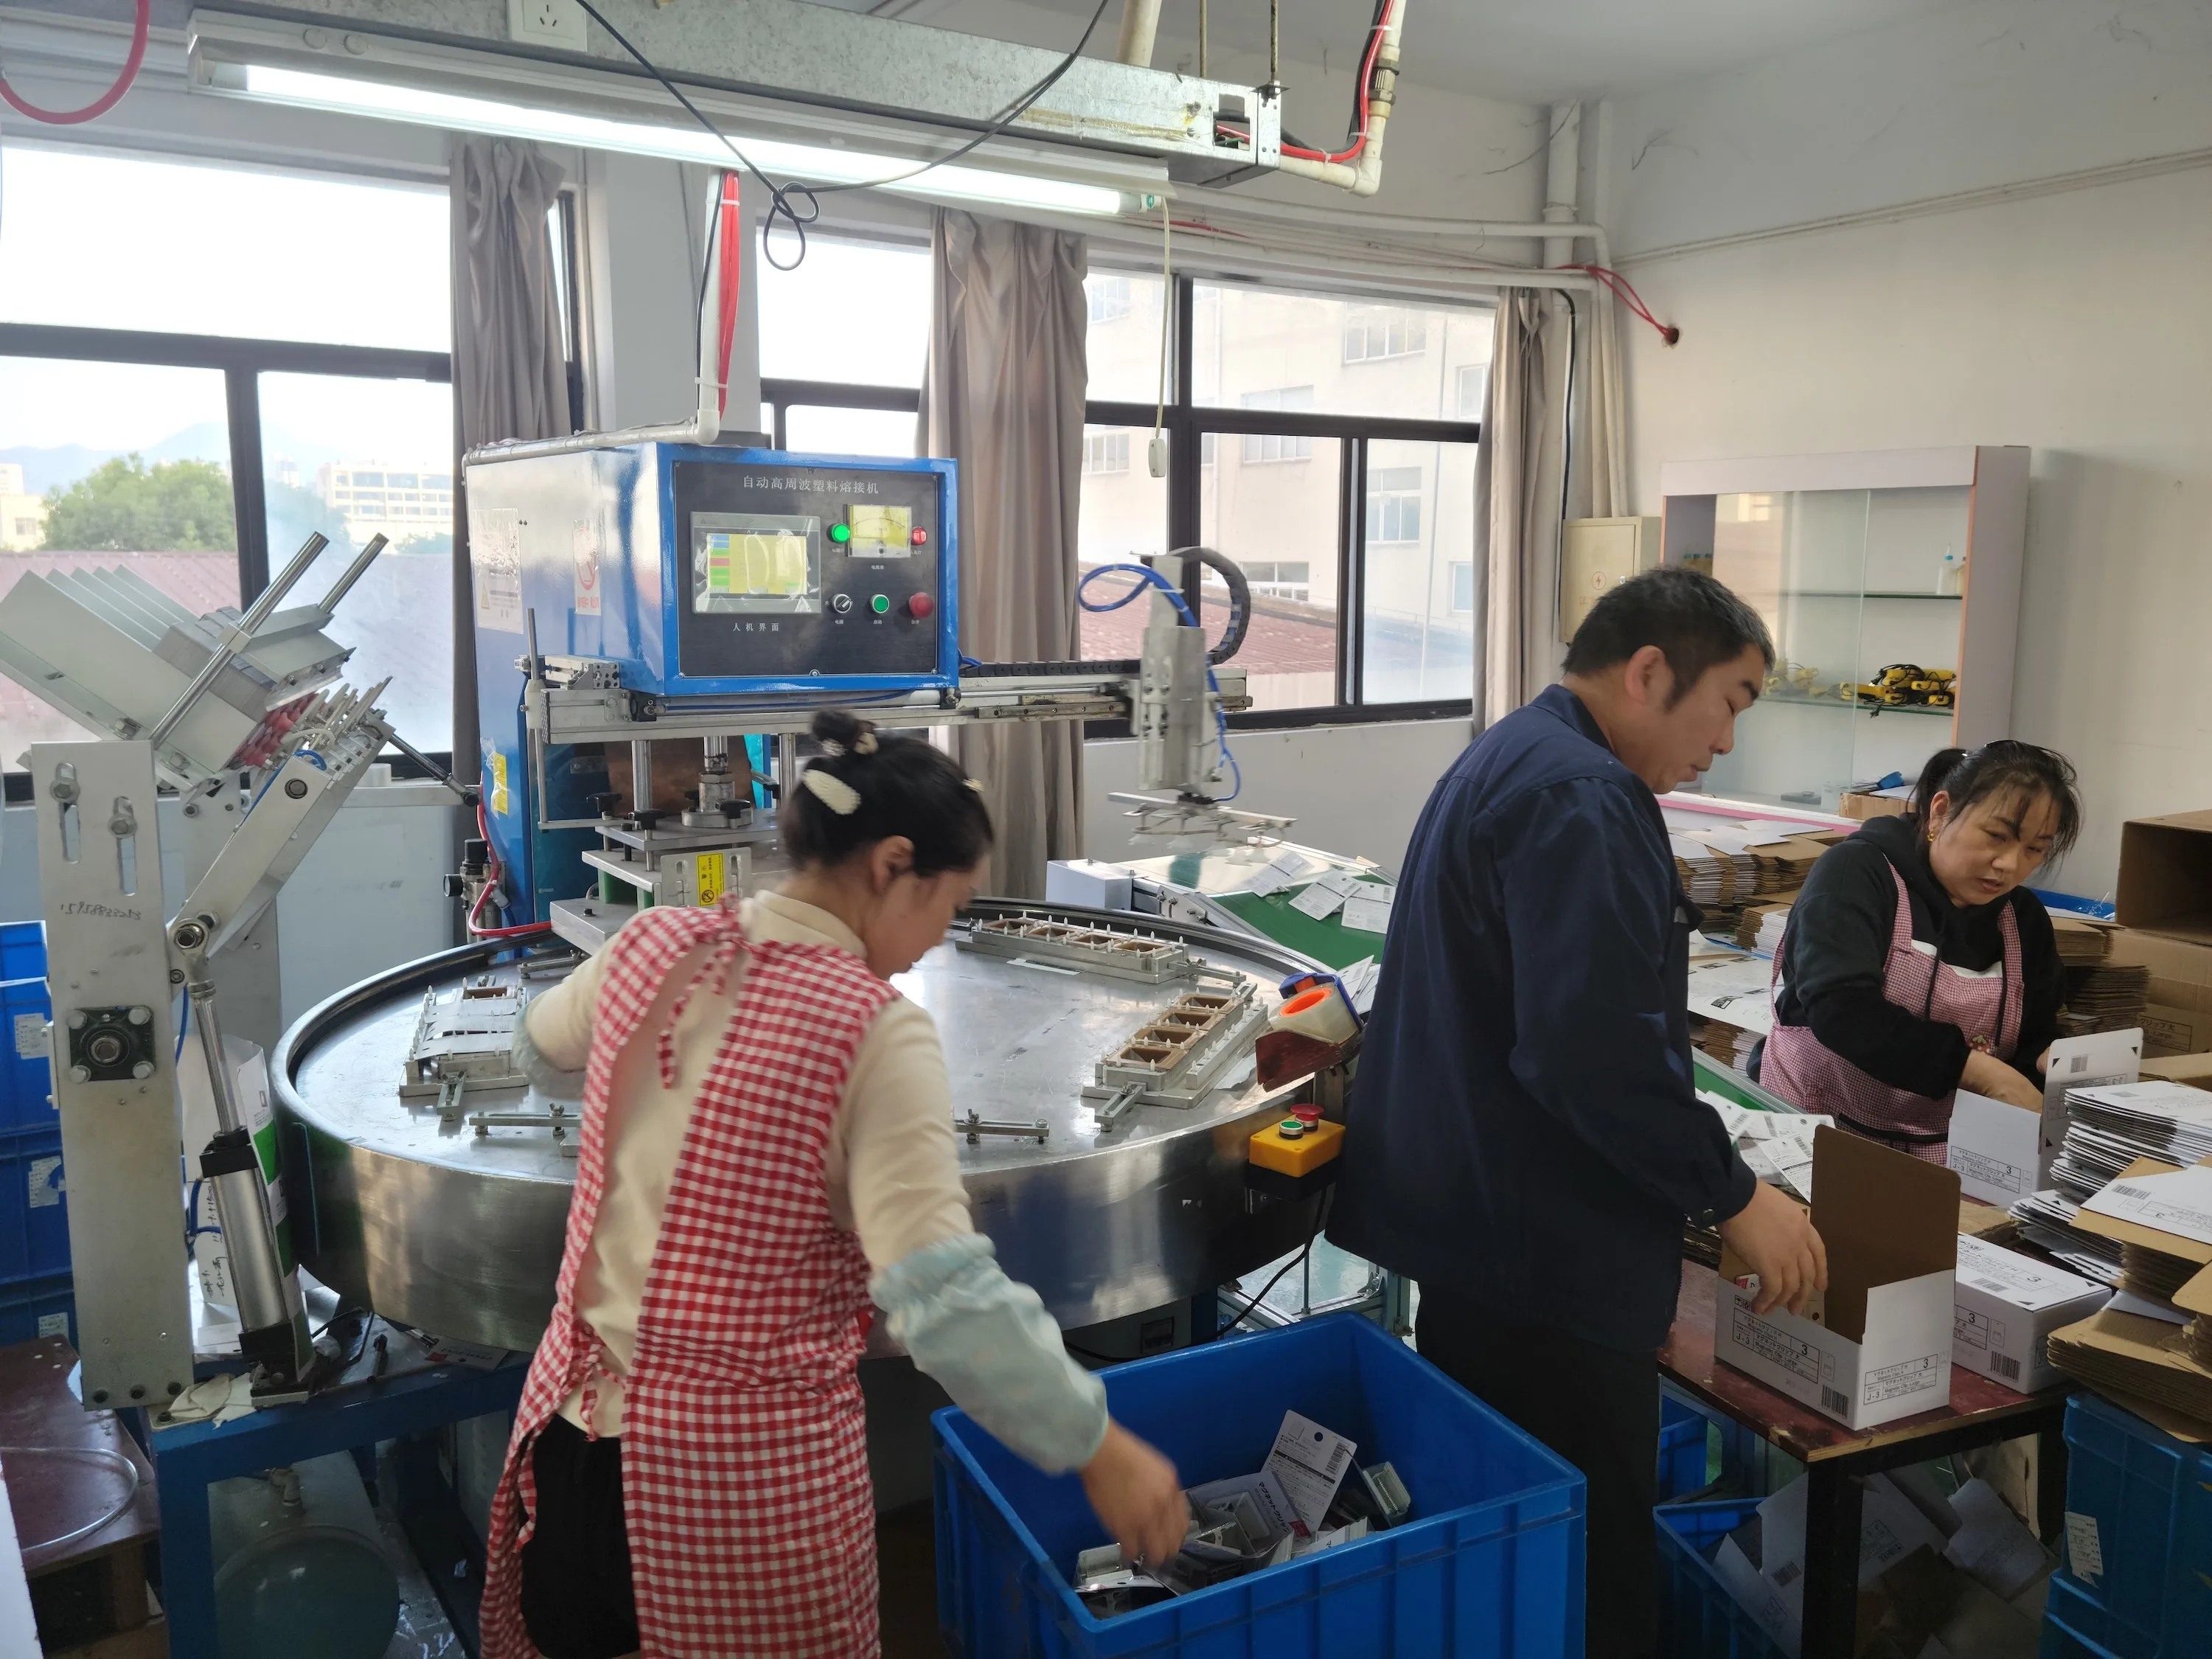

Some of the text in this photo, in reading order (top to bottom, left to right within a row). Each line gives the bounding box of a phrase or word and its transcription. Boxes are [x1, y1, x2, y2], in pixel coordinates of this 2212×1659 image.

[743, 475, 879, 494] 自动高周波塑料熔接机
[732, 622, 779, 632] 人机界面
[2006, 1166, 2011, 1175] 3
[1968, 1312, 1976, 1324] 3
[1801, 1344, 1808, 1355] 3
[1923, 1358, 1929, 1368] 3
[1885, 1374, 1916, 1385] マグネットクリップ
